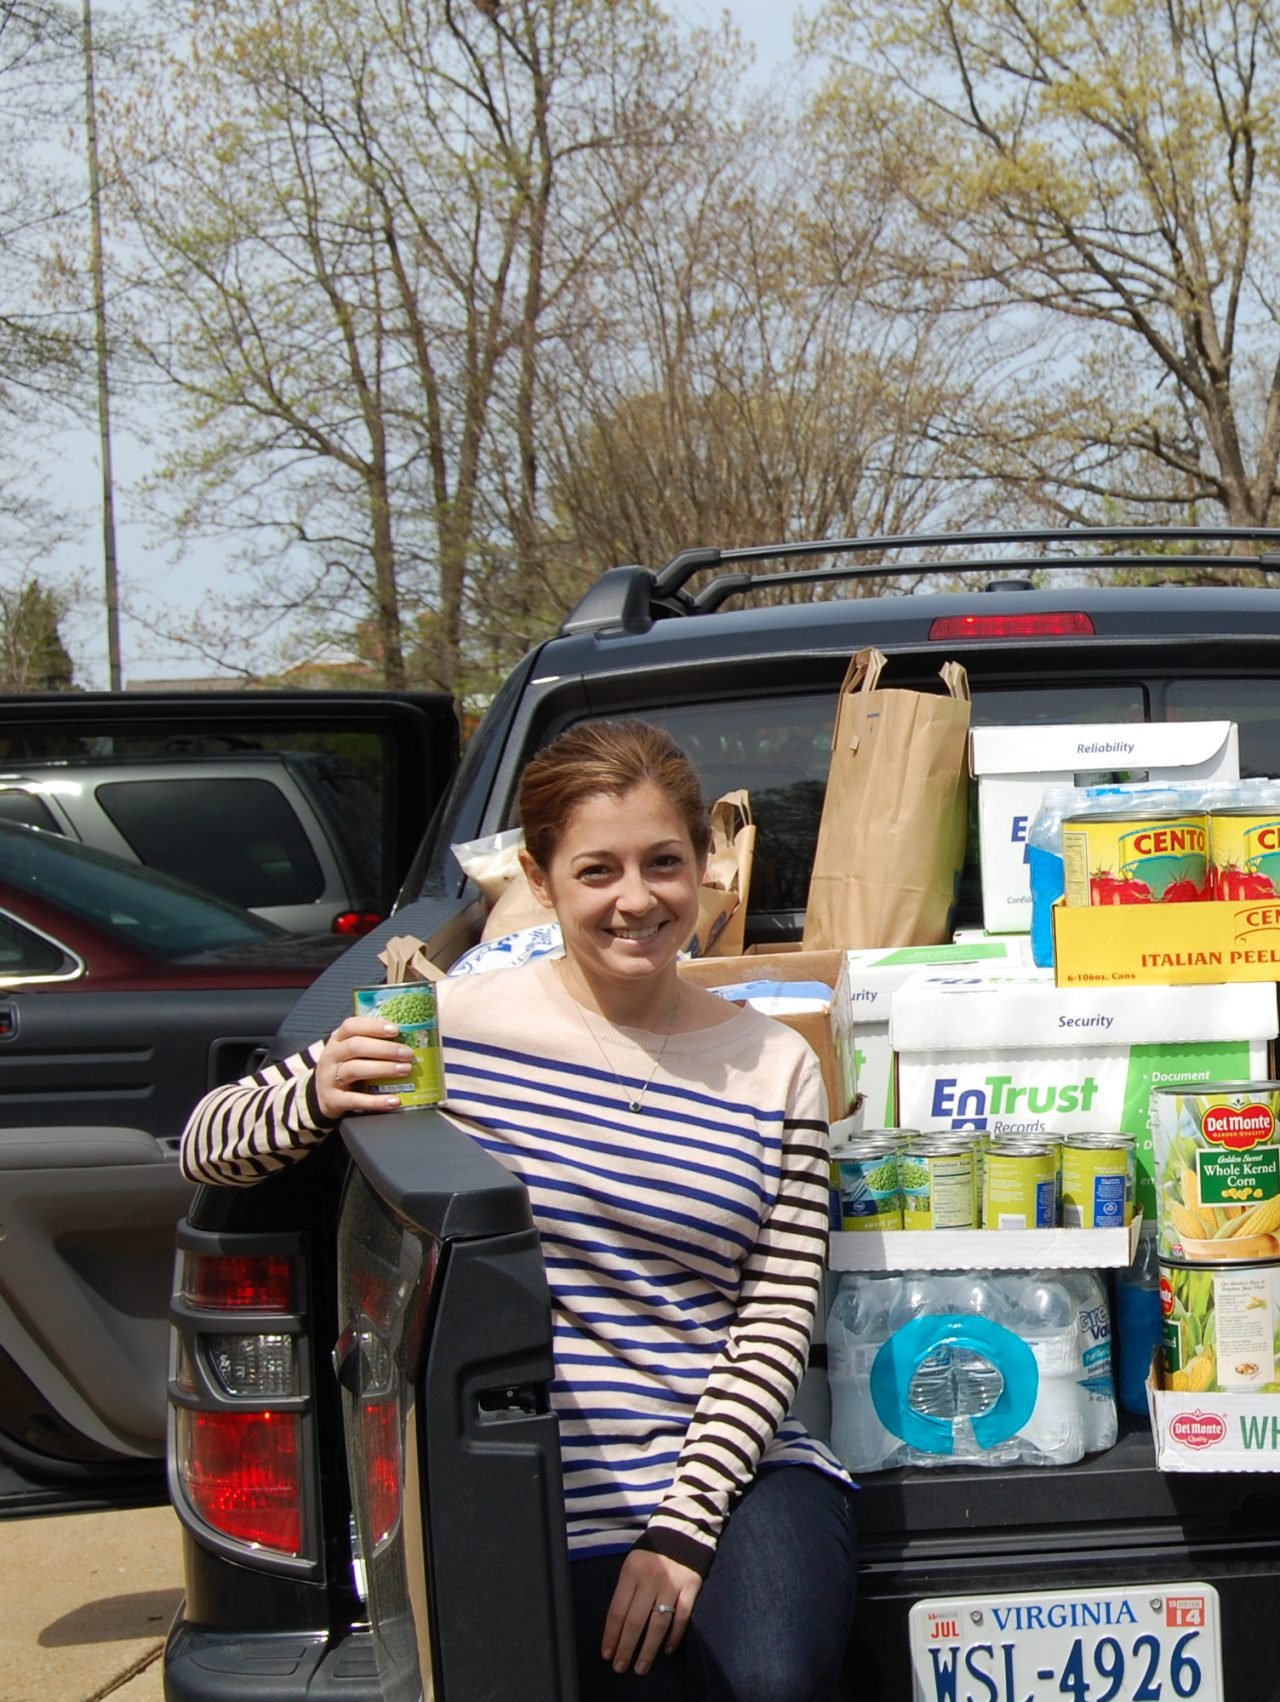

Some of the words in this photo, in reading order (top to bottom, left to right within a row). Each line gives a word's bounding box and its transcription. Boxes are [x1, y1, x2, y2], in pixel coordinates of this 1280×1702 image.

[1077, 741, 1135, 754] Reliability
[1134, 829, 1205, 855] CENTO
[1141, 952, 1222, 968] ITALIAN
[1112, 972, 1137, 981] Cans
[1058, 1014, 1114, 1029] Security
[1151, 1071, 1210, 1082] Document
[931, 1076, 1098, 1117] EnTrust
[1207, 1117, 1228, 1132] Del
[1229, 1115, 1271, 1131] Monte
[1217, 1154, 1242, 1164] Golden
[1243, 1154, 1264, 1163] Sweet
[1204, 1164, 1240, 1177] Whole
[1243, 1163, 1277, 1175] Kernel
[1227, 1175, 1256, 1187] Corn
[1175, 1423, 1190, 1435] Del
[1191, 1423, 1222, 1435] Monte
[991, 1600, 1138, 1631] VIRGINIA
[1176, 1609, 1201, 1625] 14
[931, 1621, 960, 1639] JUL
[928, 1631, 1201, 1702] WSL-4926
